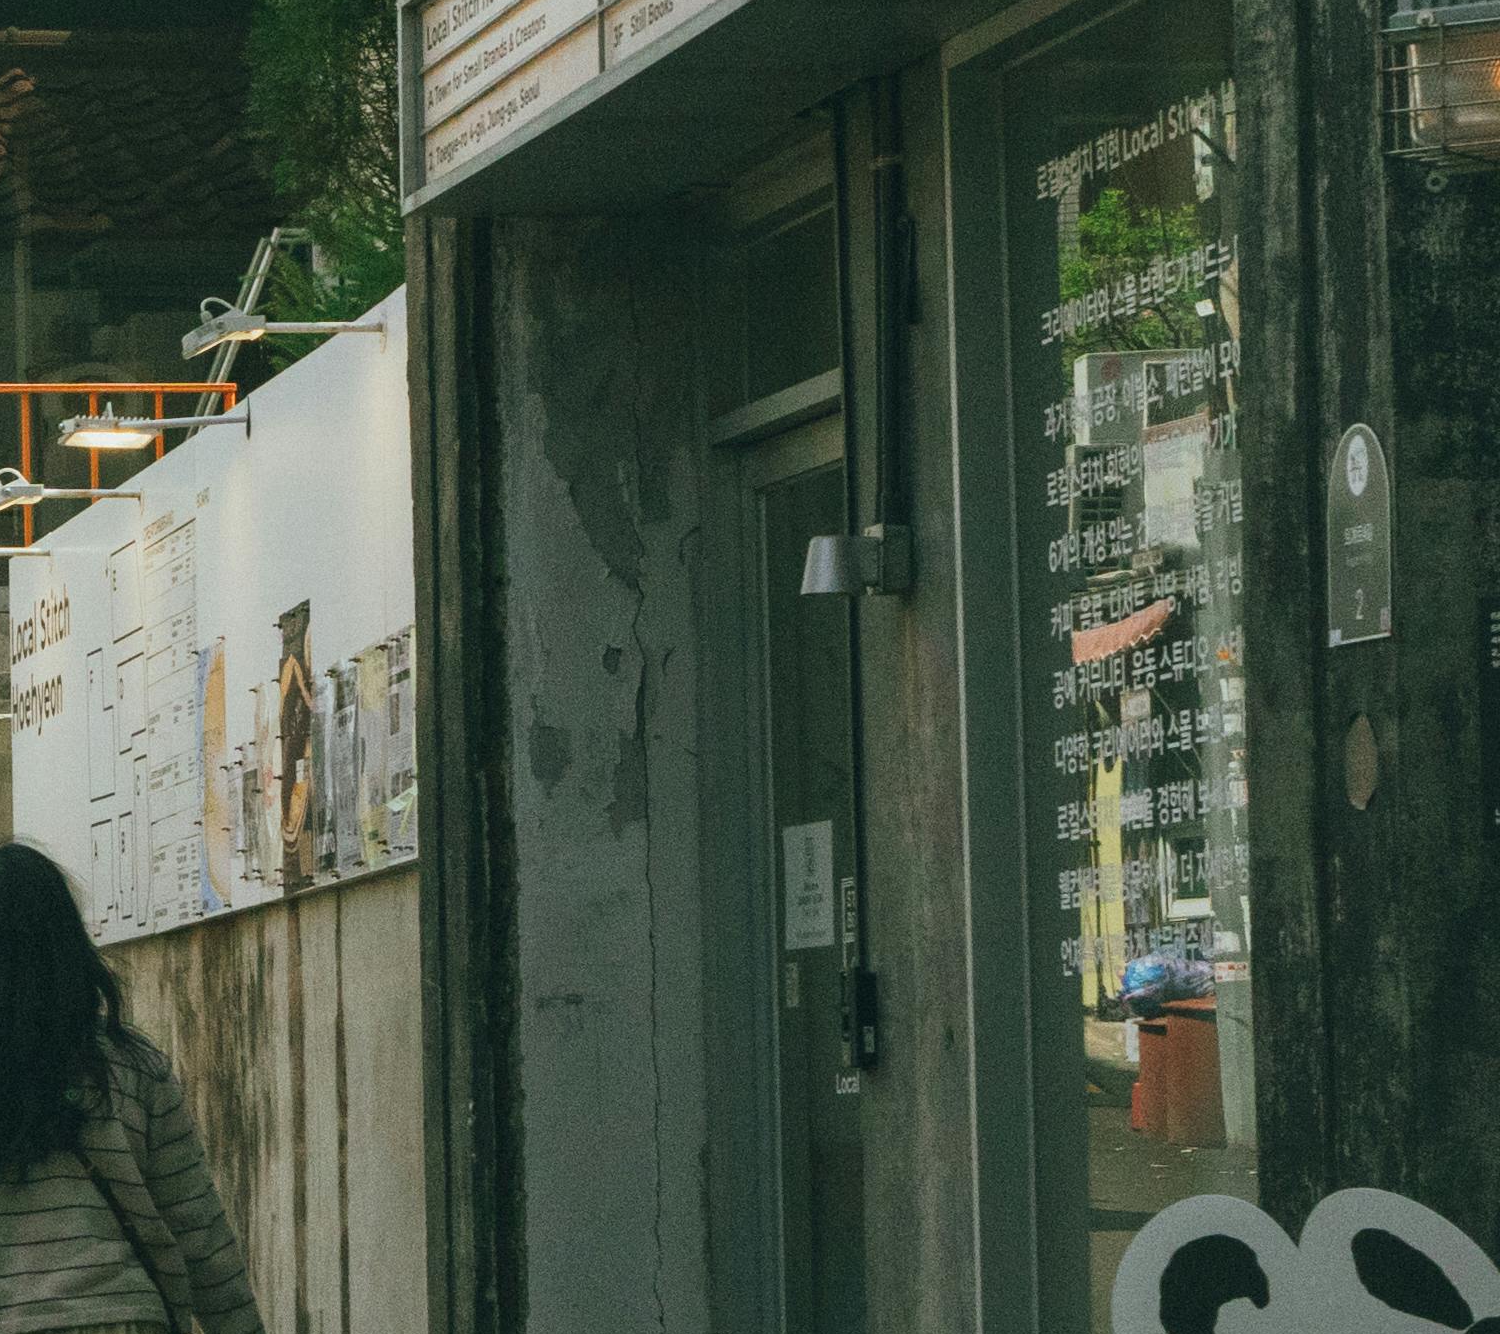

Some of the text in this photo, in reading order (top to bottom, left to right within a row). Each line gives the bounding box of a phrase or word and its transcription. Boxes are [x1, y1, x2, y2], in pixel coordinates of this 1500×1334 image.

[426, 10, 450, 51] Local
[629, 8, 648, 38] Still
[452, 71, 462, 91] for
[463, 58, 482, 85] Small
[483, 42, 508, 71] Brands
[507, 36, 515, 54] &
[515, 13, 548, 49] Creators
[519, 74, 541, 110] Seoul
[1123, 109, 1164, 161] Local
[1049, 528, 1080, 573] 6개의
[11, 582, 71, 665] Local Stitch
[1132, 645, 1157, 691] 운동
[11, 672, 64, 736] Hoehyeon
[1055, 730, 1090, 774] 다양한
[1167, 709, 1192, 751] 스몰
